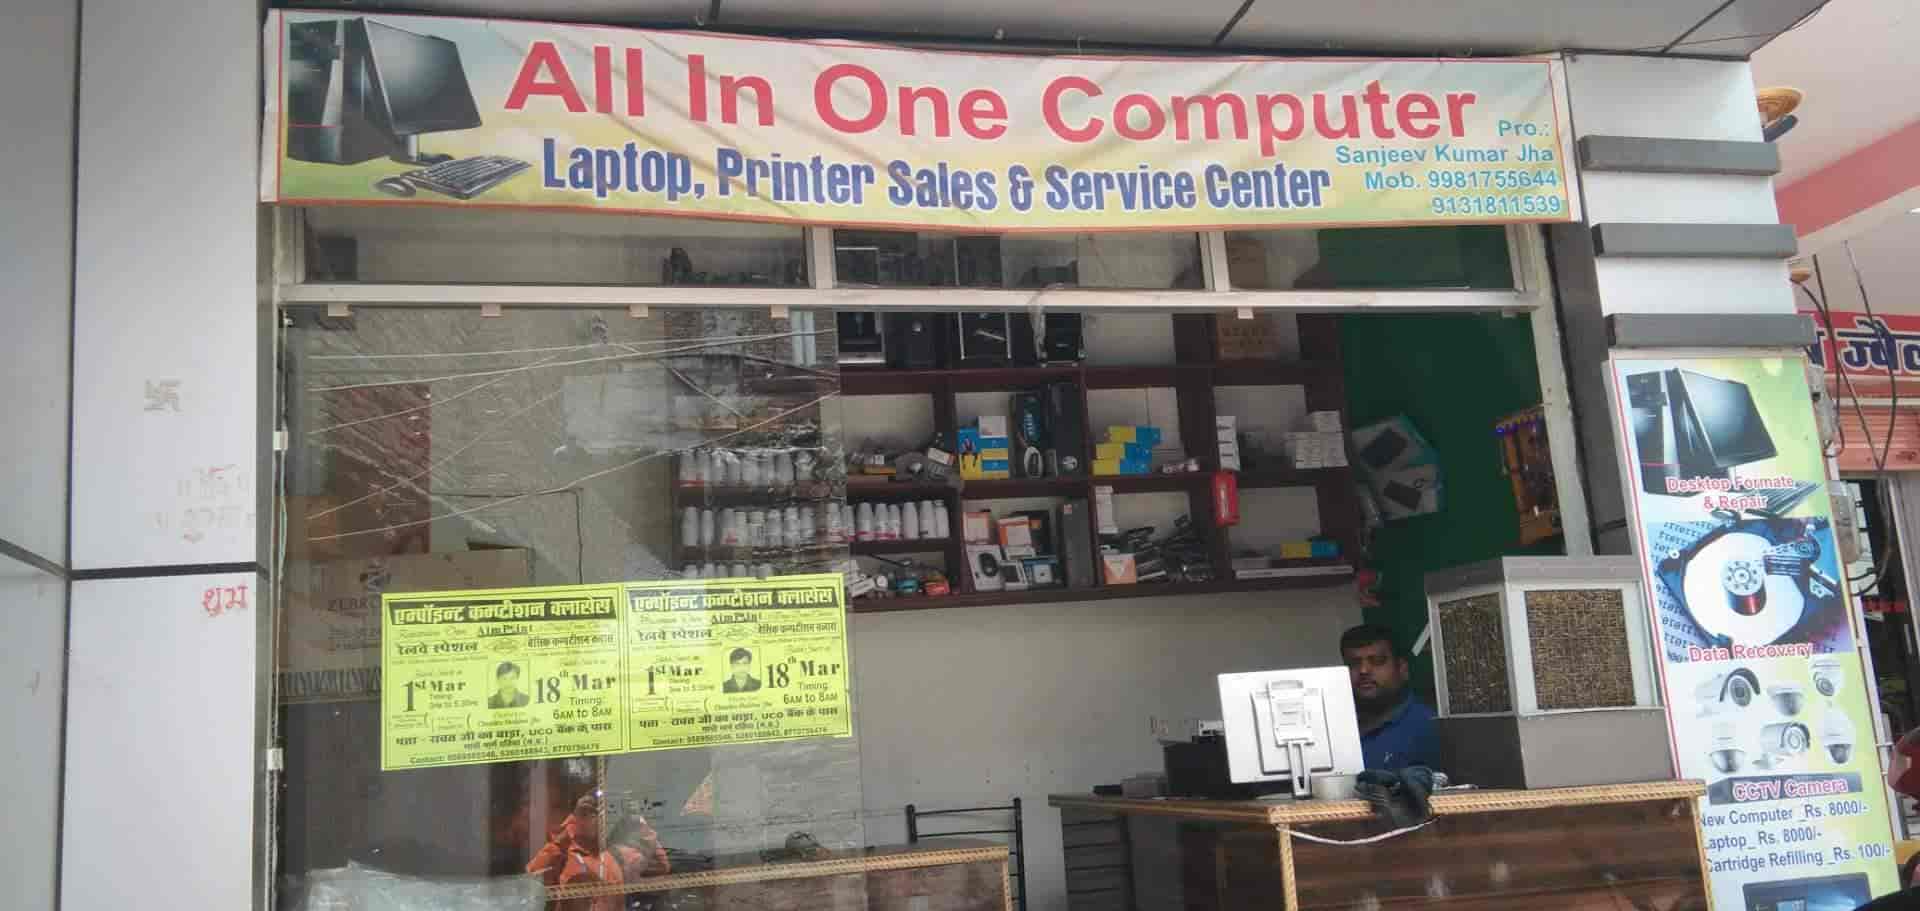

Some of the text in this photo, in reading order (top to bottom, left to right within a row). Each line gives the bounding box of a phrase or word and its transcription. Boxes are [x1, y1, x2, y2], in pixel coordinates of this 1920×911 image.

[504, 41, 1475, 157] All In One Computer
[1498, 119, 1550, 138] Pro.:
[1335, 143, 1555, 167] Sanjeev Kumar Jha
[543, 137, 1330, 211] Laptop, Printer Sales & Service Center
[1364, 170, 1558, 190] Mob. 9981755644
[1432, 194, 1561, 215] 9131811539
[1665, 475, 1793, 493] Desktop Formate
[1704, 495, 1768, 511] & Repair
[1689, 643, 1813, 662] Data Recovery
[670, 665, 703, 676] Mar
[800, 660, 840, 676] Mar
[430, 680, 466, 692] Mar
[573, 674, 616, 690] Mar
[784, 694, 802, 704] 6AM
[805, 693, 815, 703] to
[819, 692, 837, 702] 8AM
[553, 709, 573, 720] 6AM
[577, 707, 588, 718] to
[592, 706, 612, 717] 8AM
[1732, 778, 1848, 800] CCTV Camera
[1730, 807, 1793, 826] Computer
[1829, 800, 1867, 817] 8000/-
[1783, 827, 1822, 843] 8000/-
[1768, 851, 1823, 869] Refilling
[1858, 844, 1890, 859] 100/-
